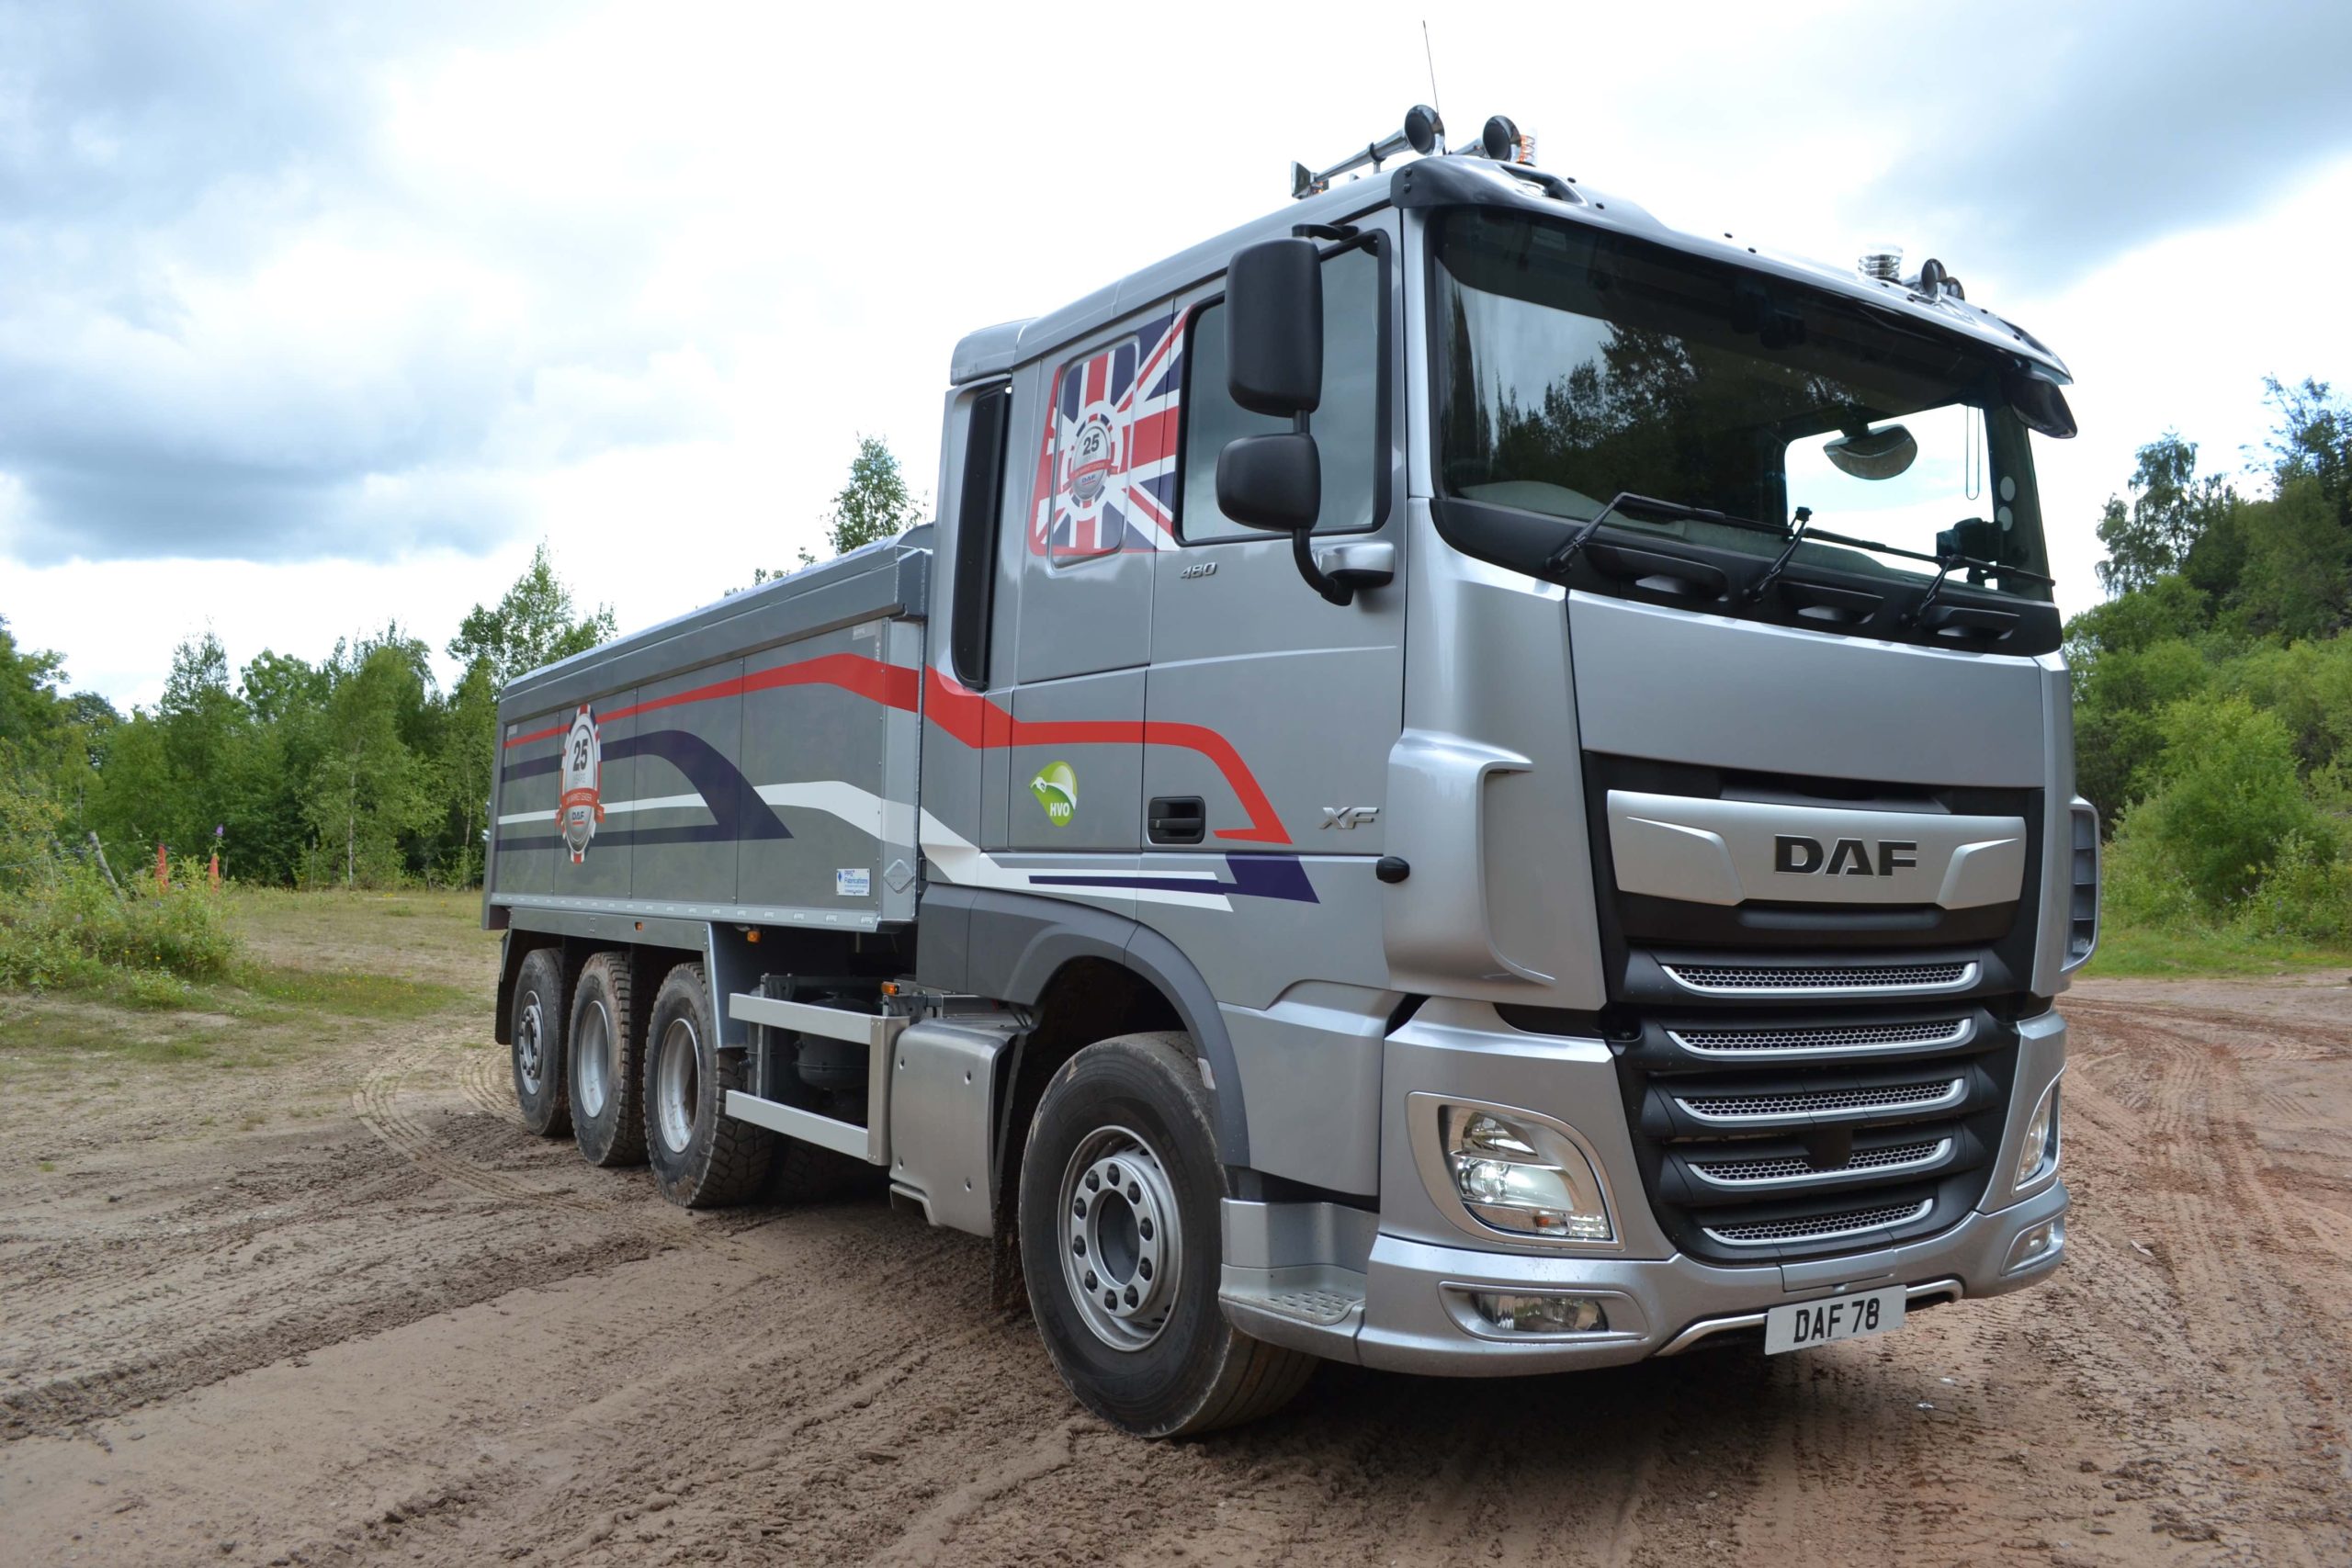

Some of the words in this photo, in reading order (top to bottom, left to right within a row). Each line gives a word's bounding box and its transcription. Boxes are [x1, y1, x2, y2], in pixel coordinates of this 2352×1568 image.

[1083, 433, 1100, 456] 25
[1081, 474, 1096, 483] DAF
[1180, 561, 1217, 580] 480
[572, 739, 588, 772] 25
[571, 811, 585, 820] DAF
[1049, 802, 1070, 817] HVO
[1319, 807, 1379, 829] XF
[1774, 833, 1918, 878] DAF
[1793, 1303, 1843, 1343] DAF
[1851, 1297, 1881, 1333] 78
